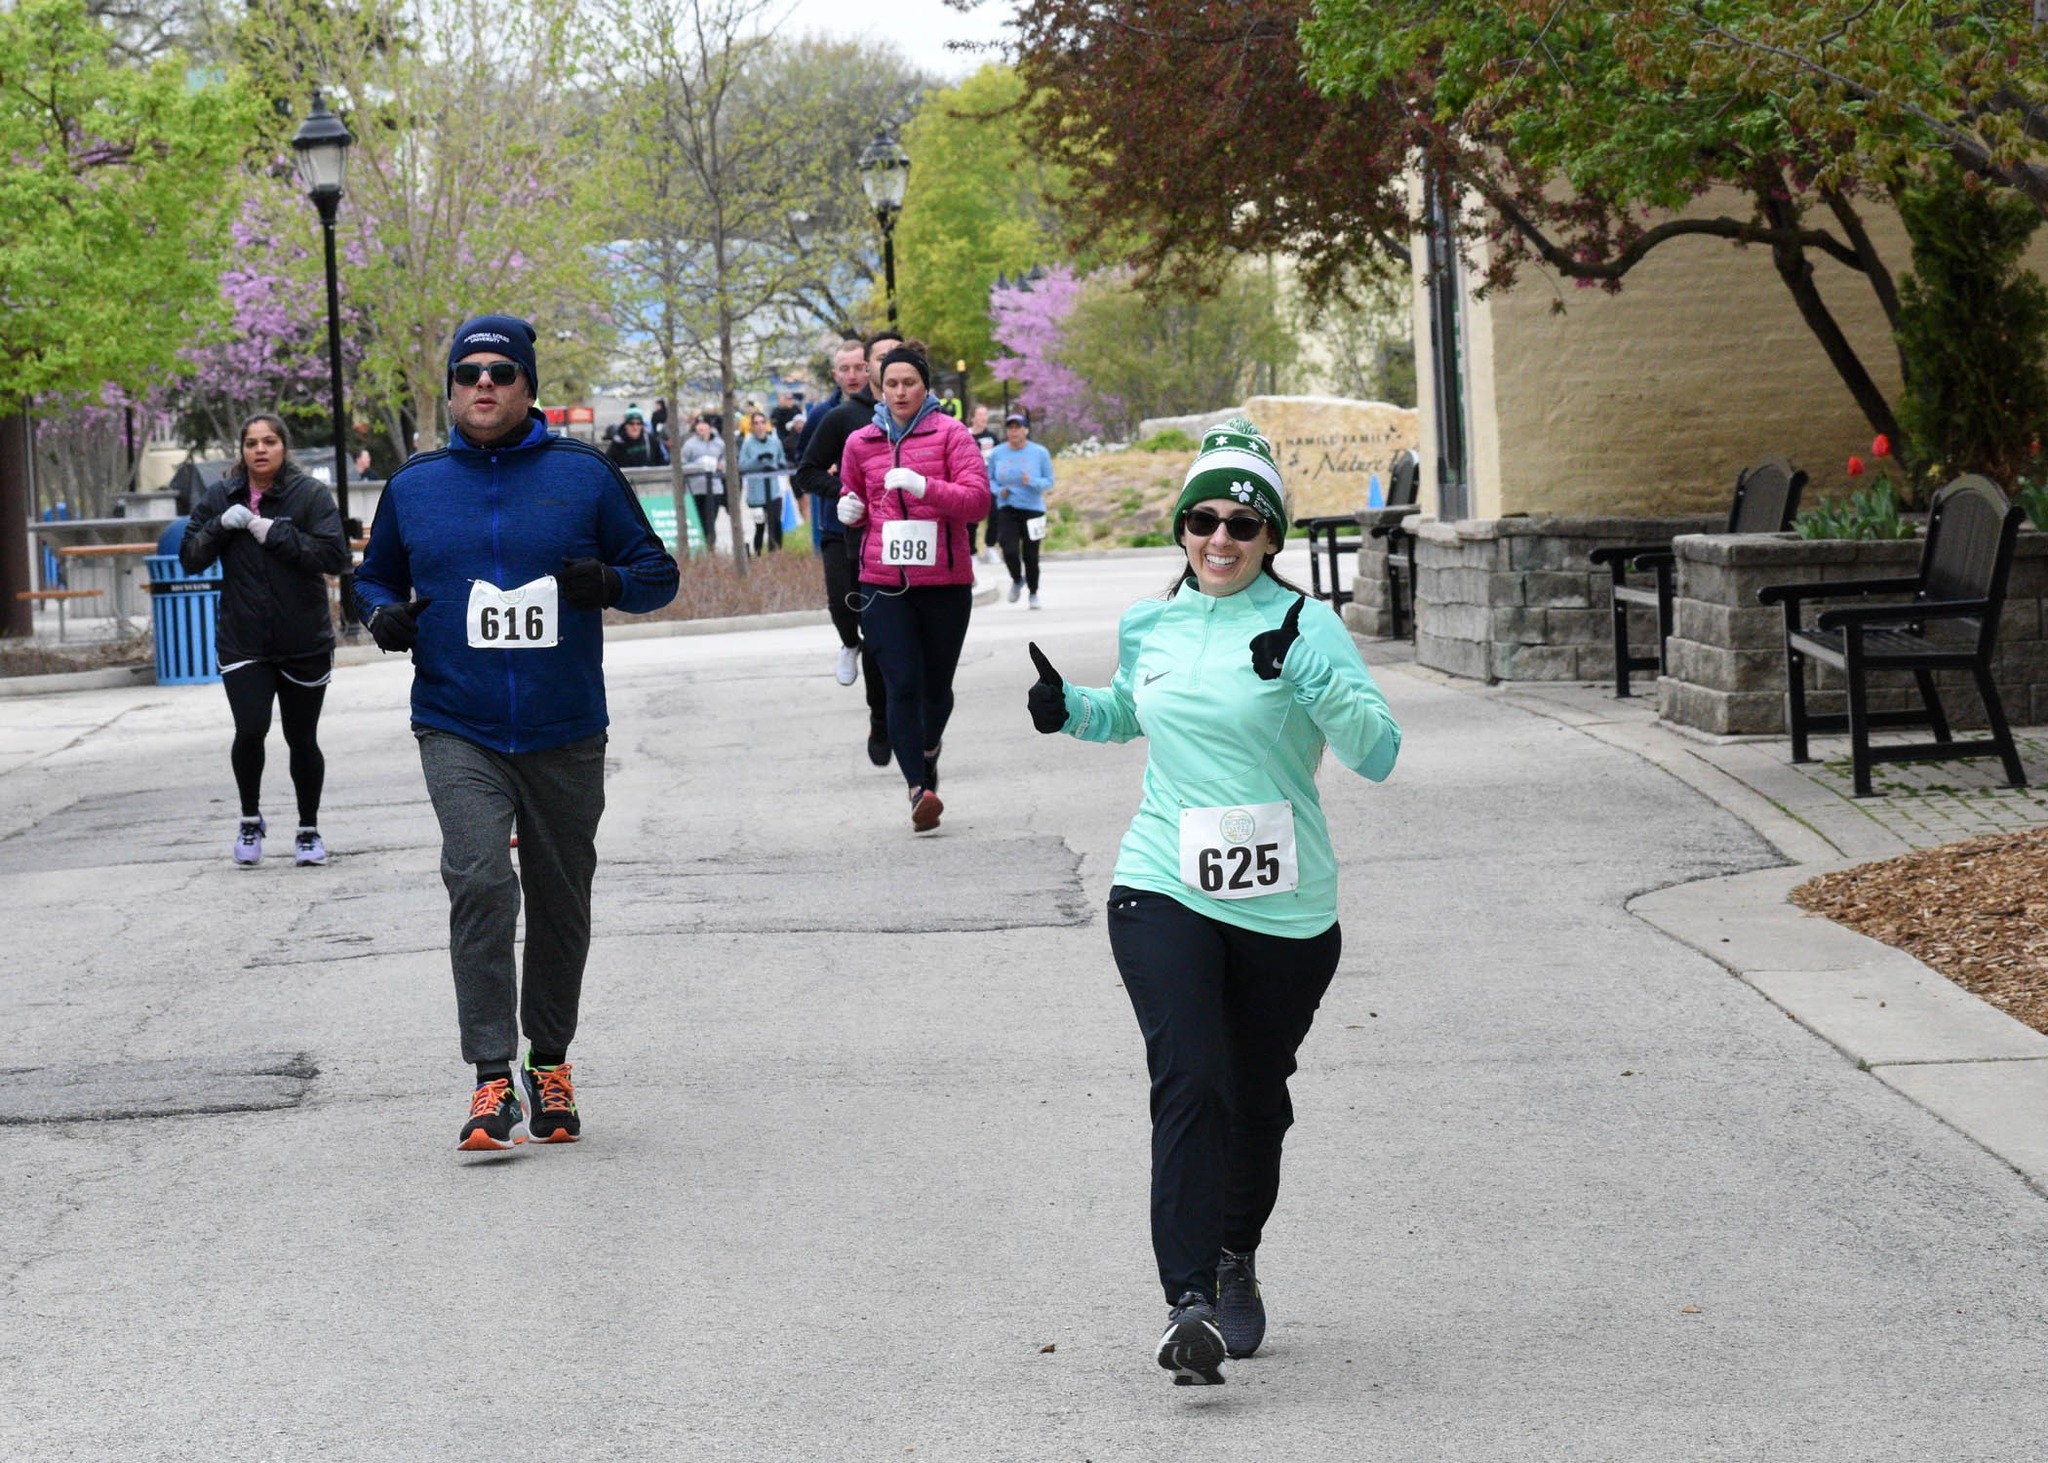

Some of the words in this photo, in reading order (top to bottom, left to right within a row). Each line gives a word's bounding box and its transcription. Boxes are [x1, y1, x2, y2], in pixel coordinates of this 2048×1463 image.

[1342, 433, 1390, 443] FAMILY
[1312, 447, 1383, 480] Nature
[890, 539, 927, 561] 698
[481, 606, 543, 641] 616
[1199, 843, 1280, 892] 625
